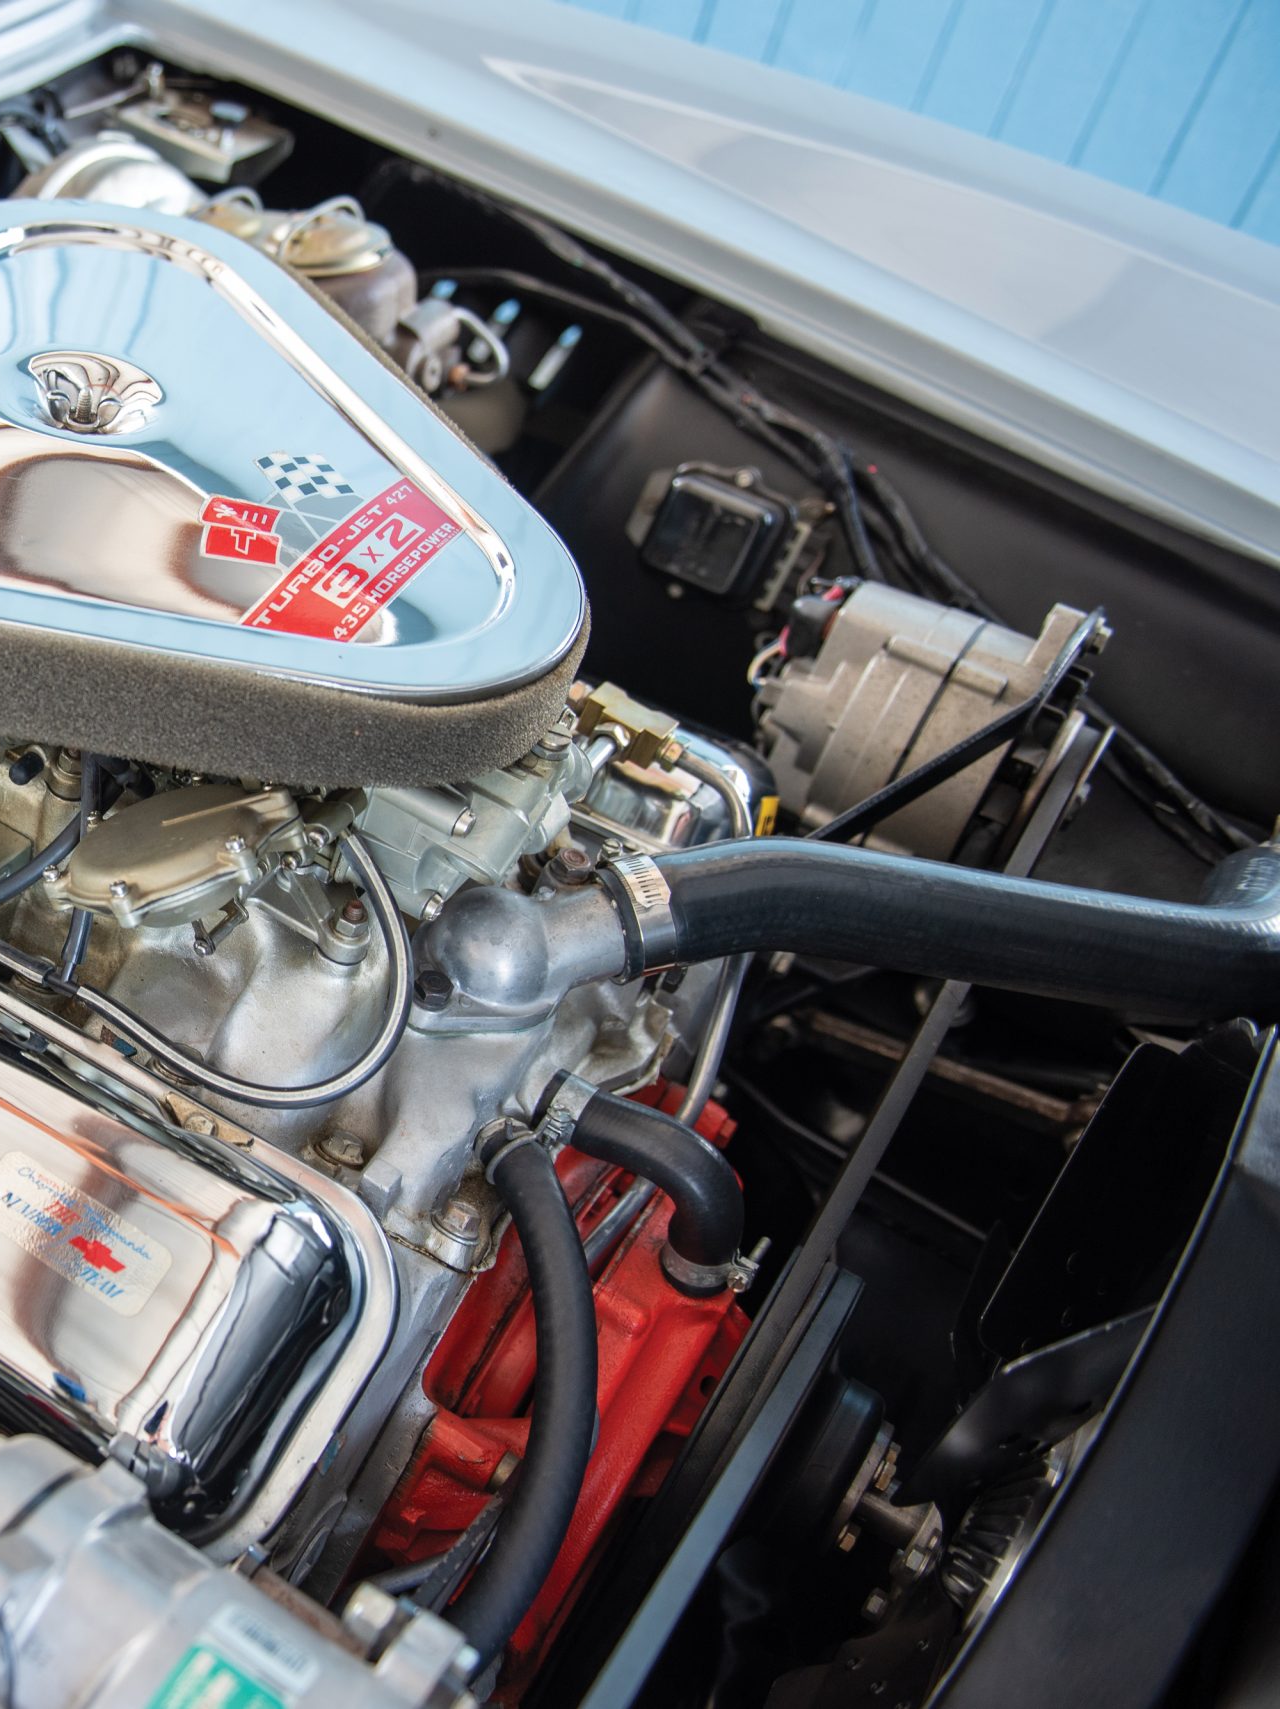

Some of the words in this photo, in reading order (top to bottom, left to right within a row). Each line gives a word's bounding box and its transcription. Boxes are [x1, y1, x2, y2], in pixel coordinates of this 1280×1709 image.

[253, 504, 384, 626] TURBO-JET
[386, 484, 412, 507] 427
[332, 602, 370, 640] 435
[366, 522, 455, 605] HORSEPOWER
